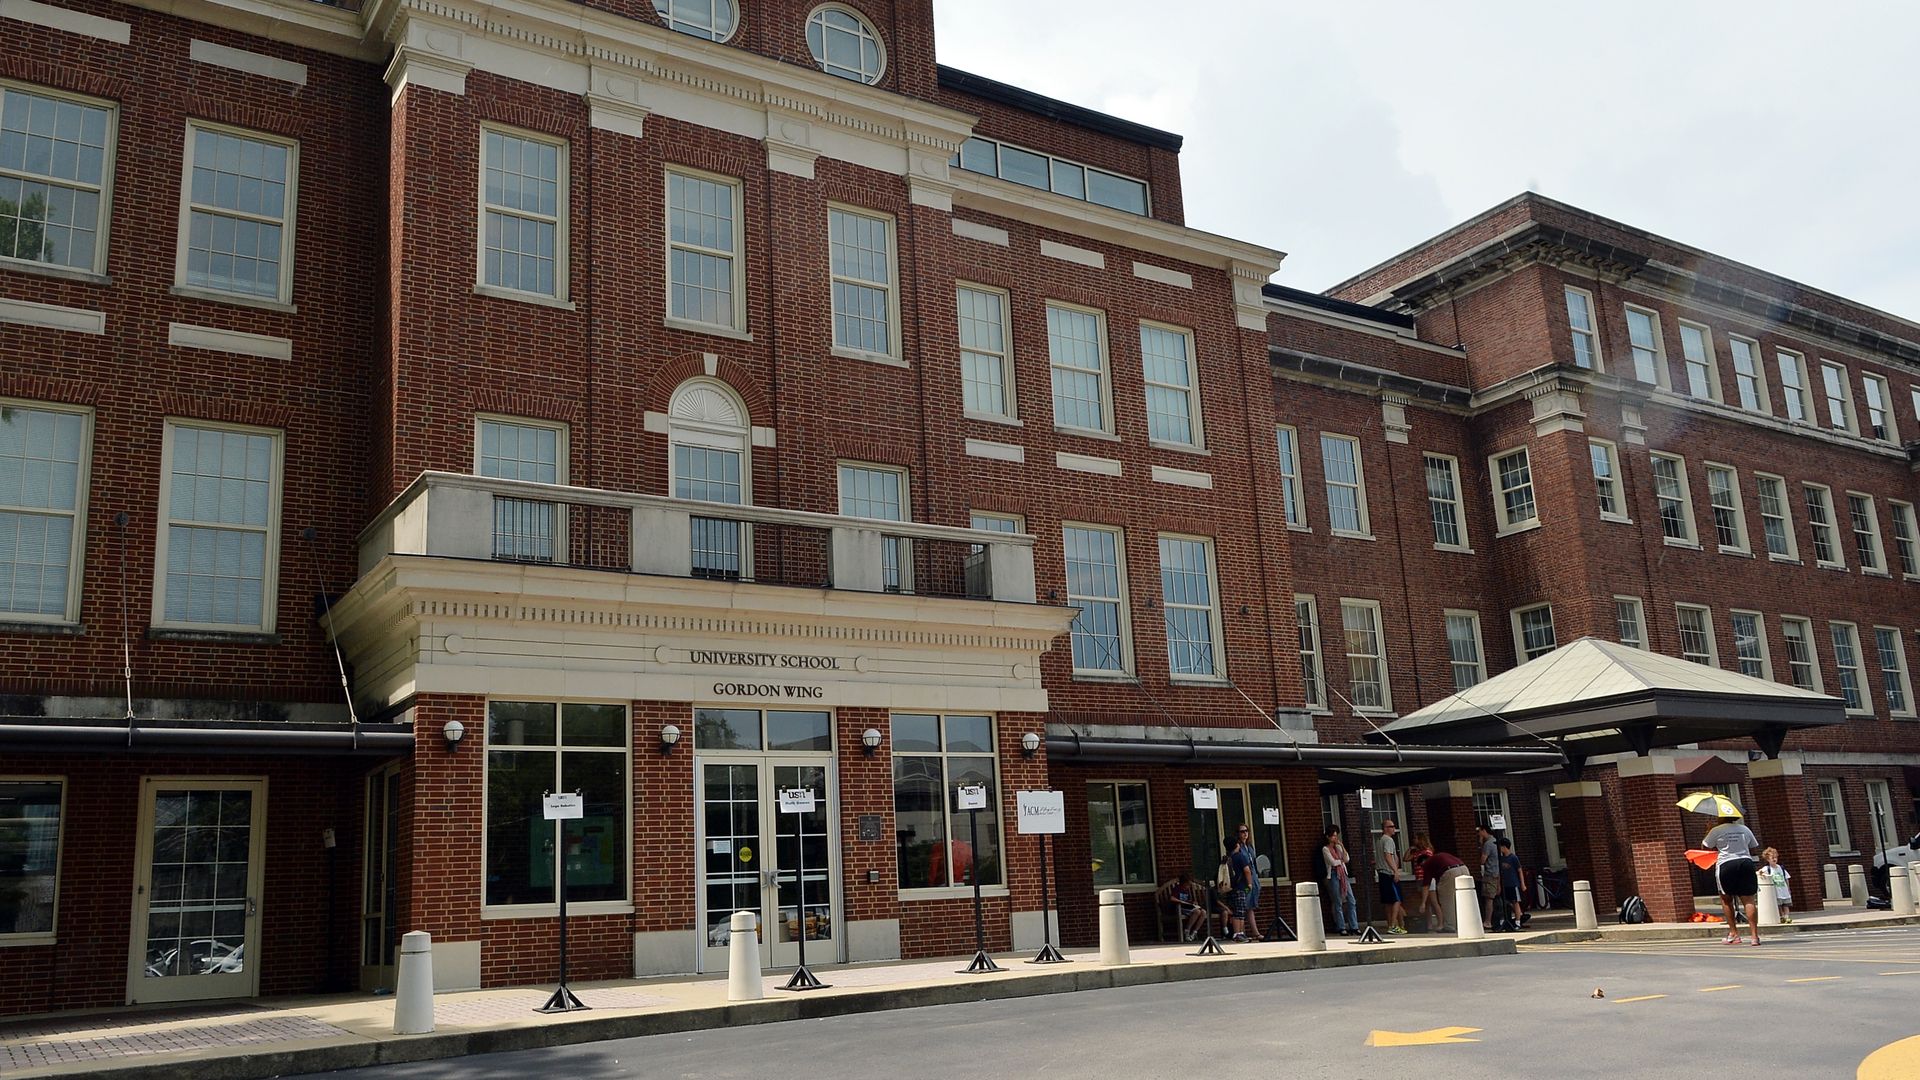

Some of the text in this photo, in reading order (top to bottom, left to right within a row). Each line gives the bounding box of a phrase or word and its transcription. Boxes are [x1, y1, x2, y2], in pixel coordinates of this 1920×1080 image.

[689, 651, 840, 669] UNIVERSITY SCHOOL
[713, 682, 823, 698] GORDON WING
